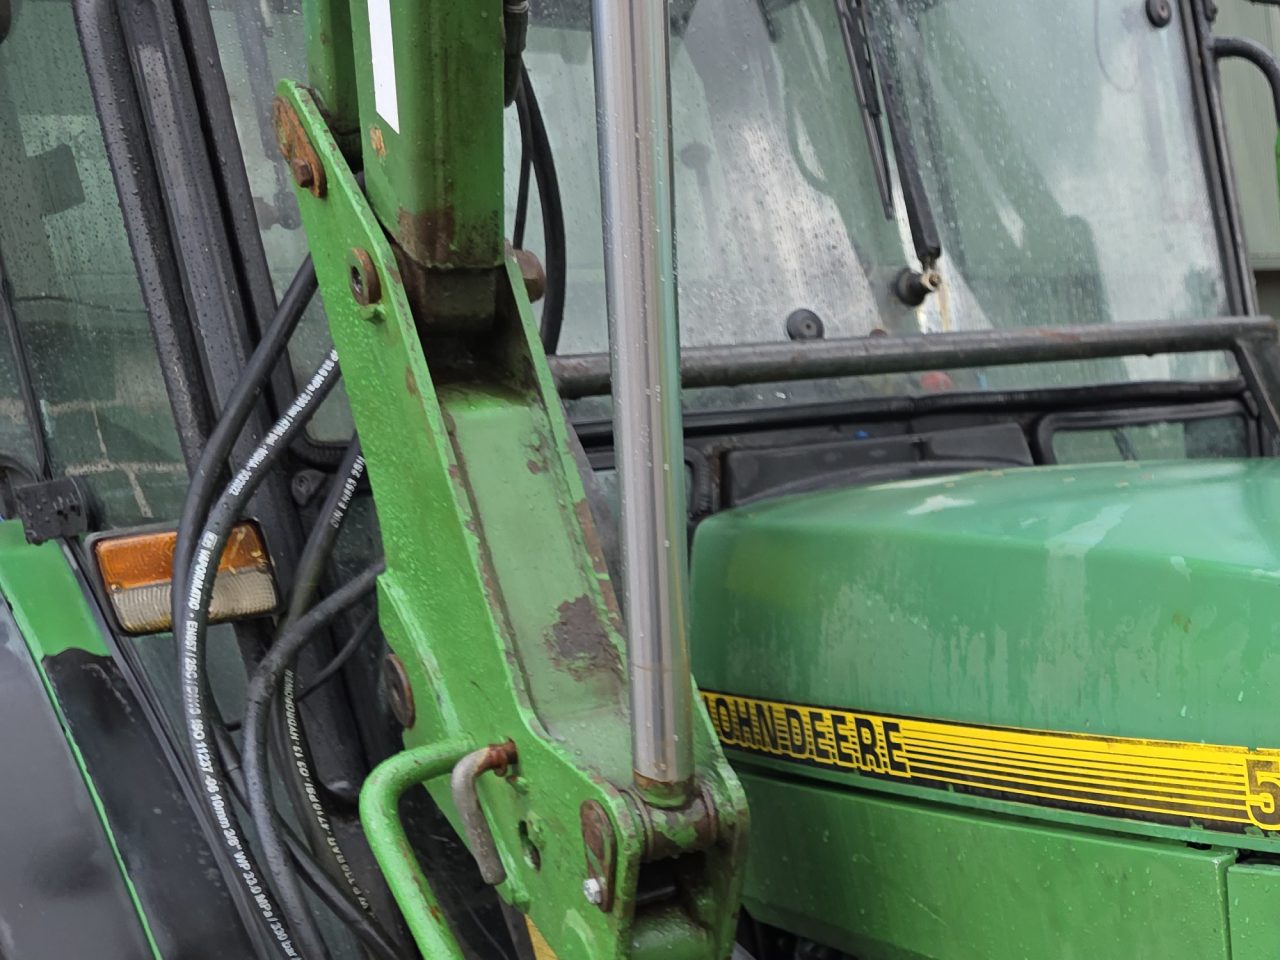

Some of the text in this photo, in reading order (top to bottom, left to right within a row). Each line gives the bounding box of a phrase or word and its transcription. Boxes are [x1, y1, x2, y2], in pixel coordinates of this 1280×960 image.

[188, 548, 211, 611] VAPORMATIC
[190, 718, 205, 740] ISO
[784, 705, 910, 778] DEERE
[195, 741, 213, 773] 11237
[209, 793, 231, 829] 10mm
